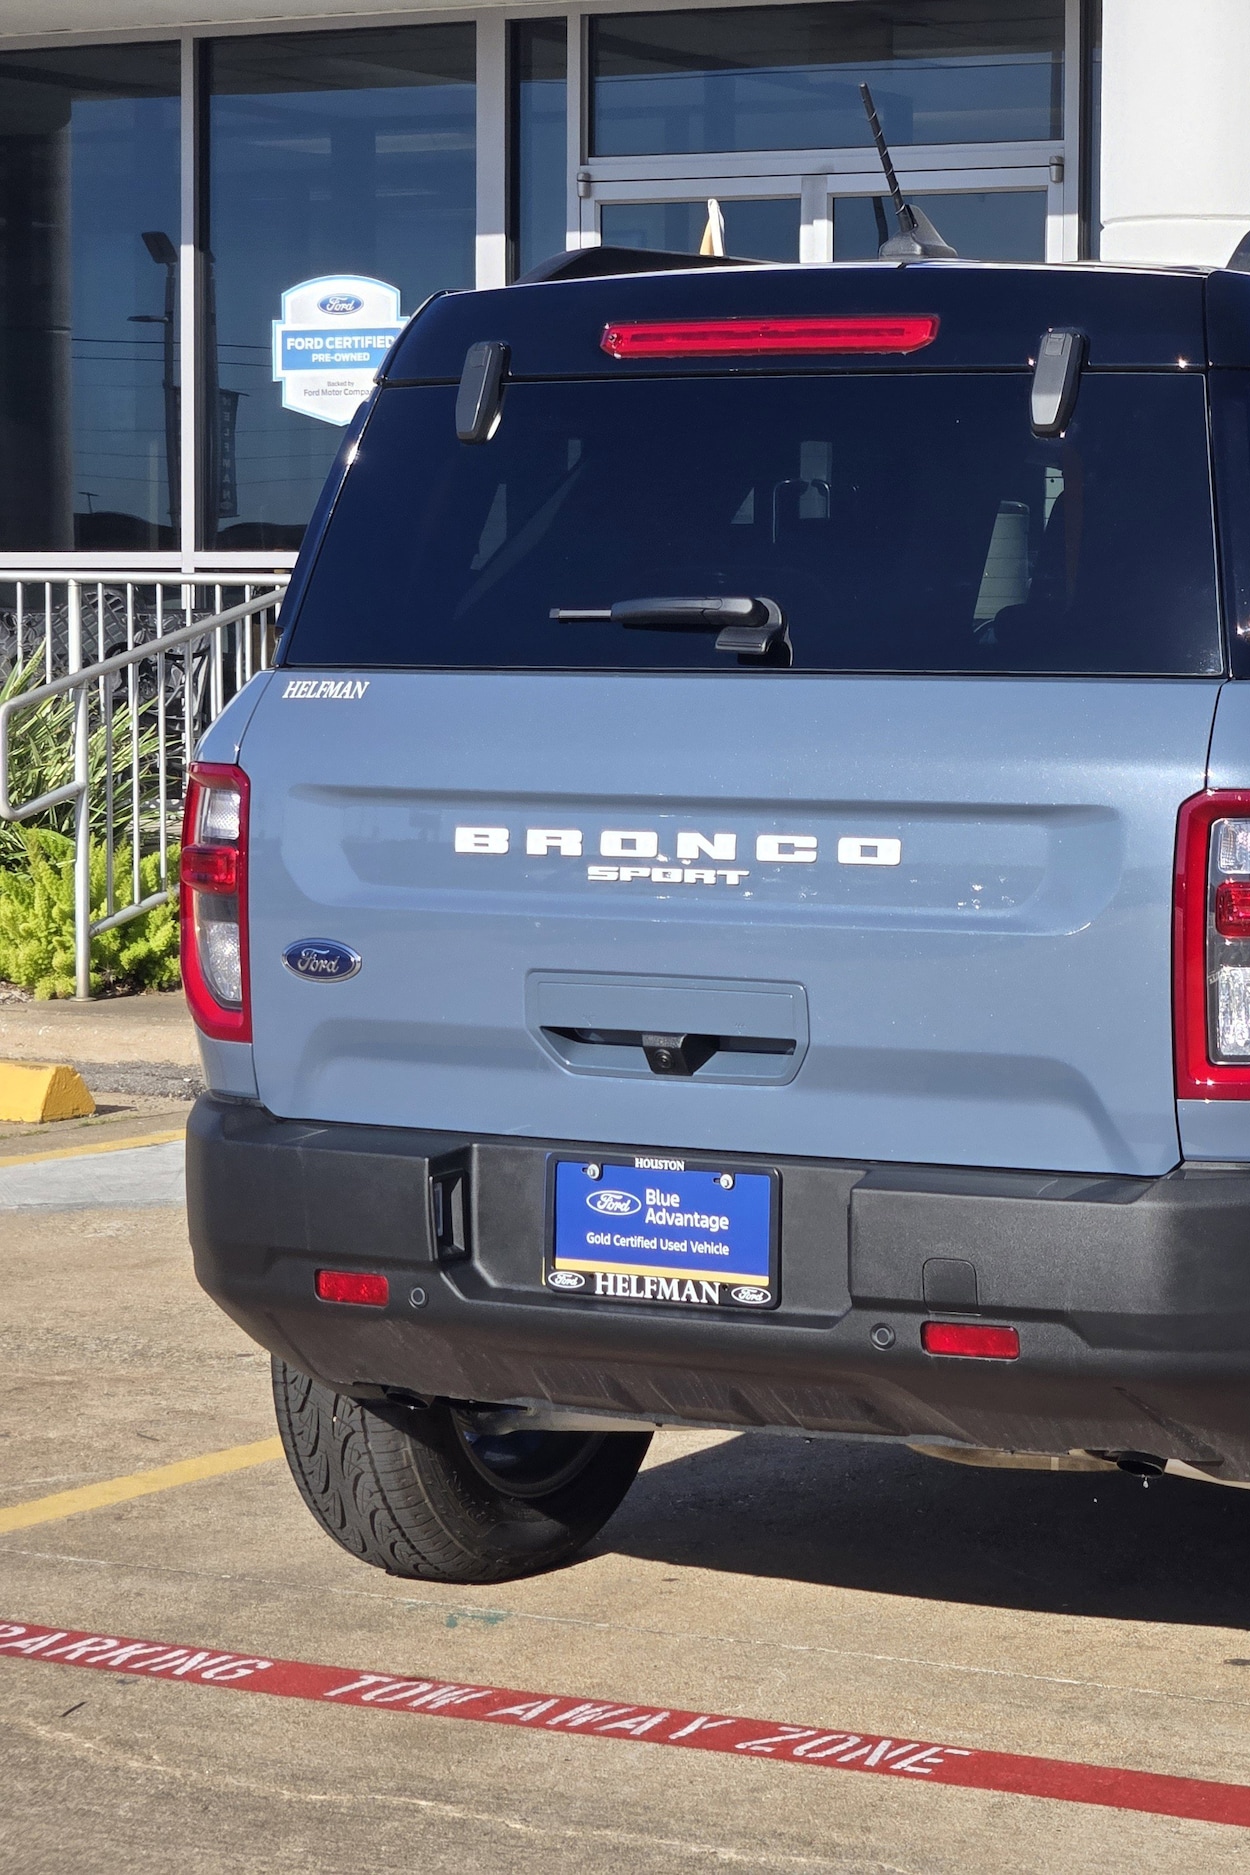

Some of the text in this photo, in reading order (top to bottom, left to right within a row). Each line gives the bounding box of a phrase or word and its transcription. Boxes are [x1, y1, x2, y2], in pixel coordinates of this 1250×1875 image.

[286, 335, 396, 350] FORD CERTIFIED
[311, 352, 371, 363] PRE-OWNED
[303, 389, 320, 397] Ford
[343, 388, 372, 397] Compa
[282, 681, 370, 699] HELFMAN
[454, 826, 901, 866] BRONCO
[587, 865, 751, 885] SPORT
[297, 948, 340, 973] Ford
[635, 1157, 685, 1171] HOUSTON
[596, 1188, 681, 1212] Ford Blue
[645, 1208, 730, 1232] Advantage
[586, 1232, 730, 1255] Gold Certified Used Vehicle
[594, 1272, 721, 1304] HELFMAN
[323, 1674, 492, 1710] TOW
[484, 1698, 735, 1740] AWAY
[735, 1725, 976, 1775] ZONE
